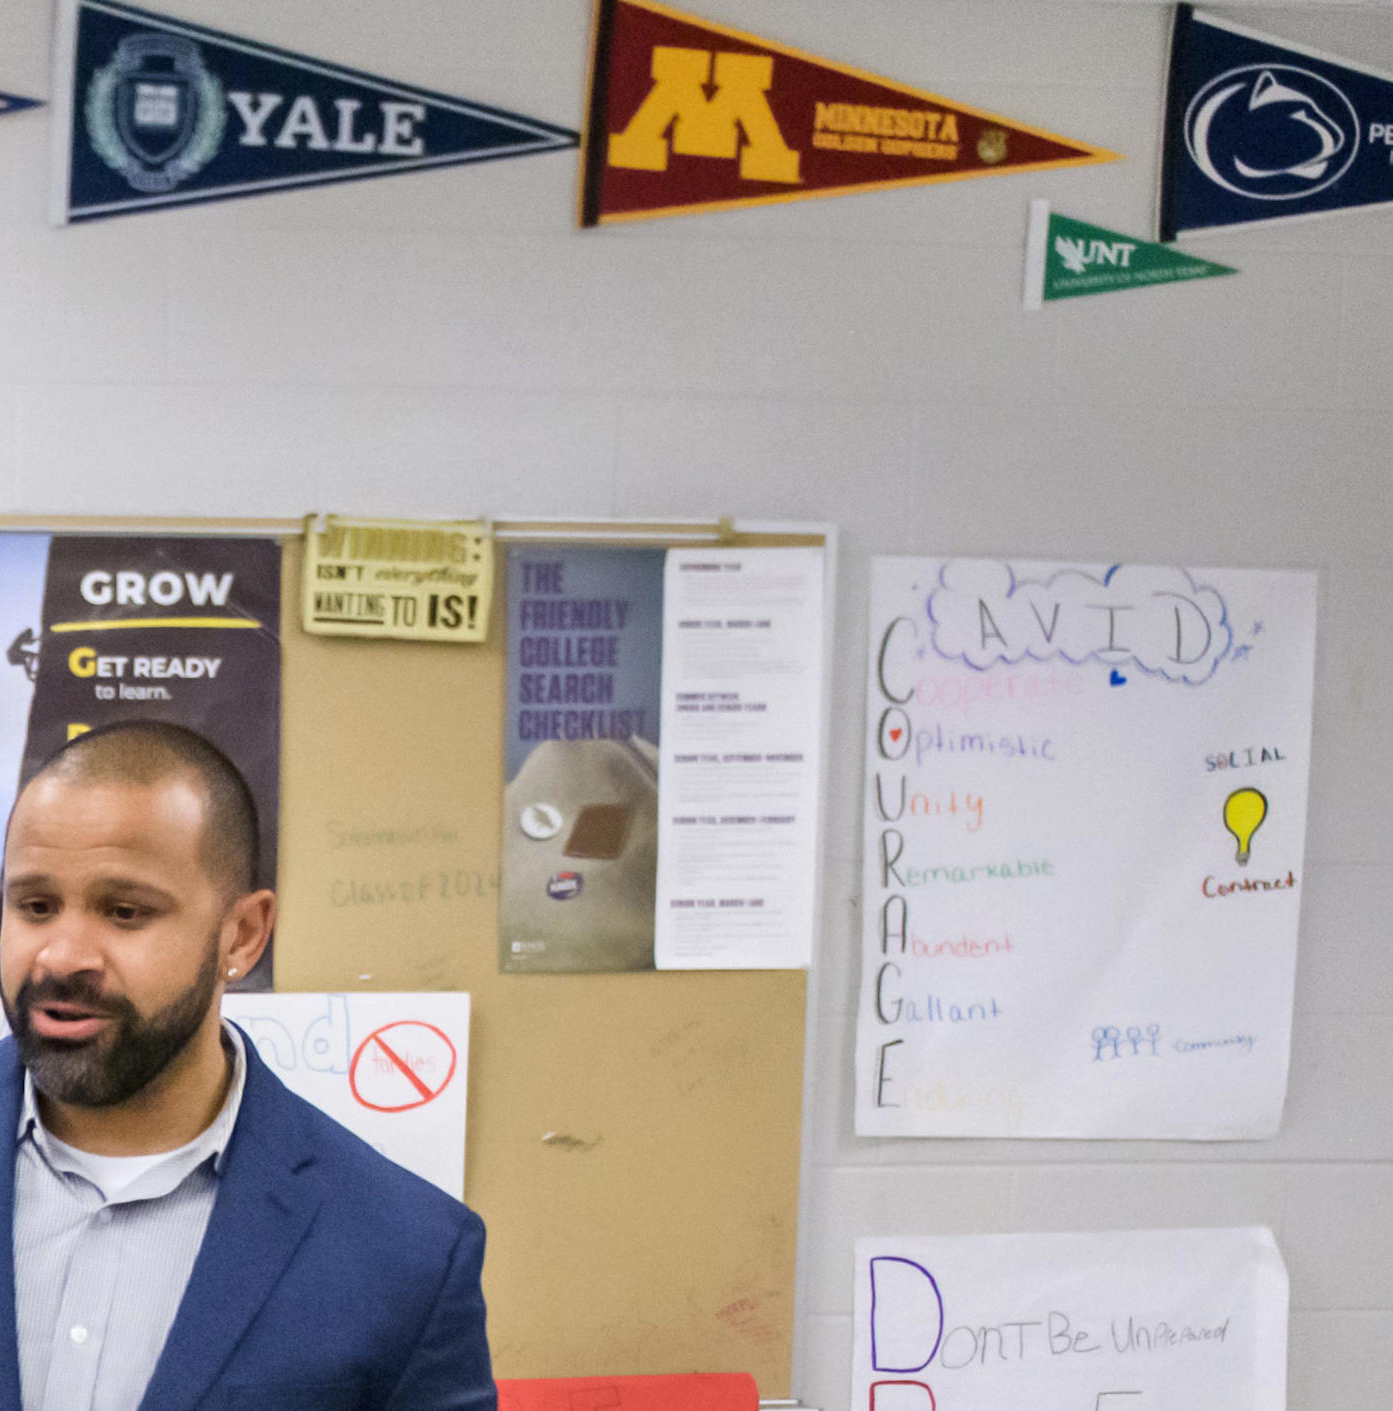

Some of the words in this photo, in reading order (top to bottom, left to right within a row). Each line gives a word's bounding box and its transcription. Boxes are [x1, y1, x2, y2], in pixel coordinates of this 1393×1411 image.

[229, 91, 426, 155] YALE
[607, 45, 802, 184] M
[814, 101, 958, 142] MINNESOTA
[1076, 238, 1137, 267] UNT
[80, 571, 234, 606] GROW
[521, 562, 566, 595] THE
[392, 596, 417, 626] TO
[428, 594, 478, 629] IS!
[520, 599, 629, 632] FRIENDLY
[979, 590, 1211, 664] AVID
[68, 647, 128, 678] GET
[133, 657, 221, 678] READY
[520, 635, 620, 668] COLLEGE
[95, 684, 115, 700] to
[119, 683, 172, 701] learn.
[519, 672, 615, 705] SEARCH
[518, 710, 647, 741] CHECKLIST
[878, 707, 1057, 766] Optimistic
[876, 772, 983, 832] Unity
[881, 829, 1058, 888] Remarkable
[876, 962, 1002, 1025] Gallant
[1047, 1311, 1101, 1354] Be
